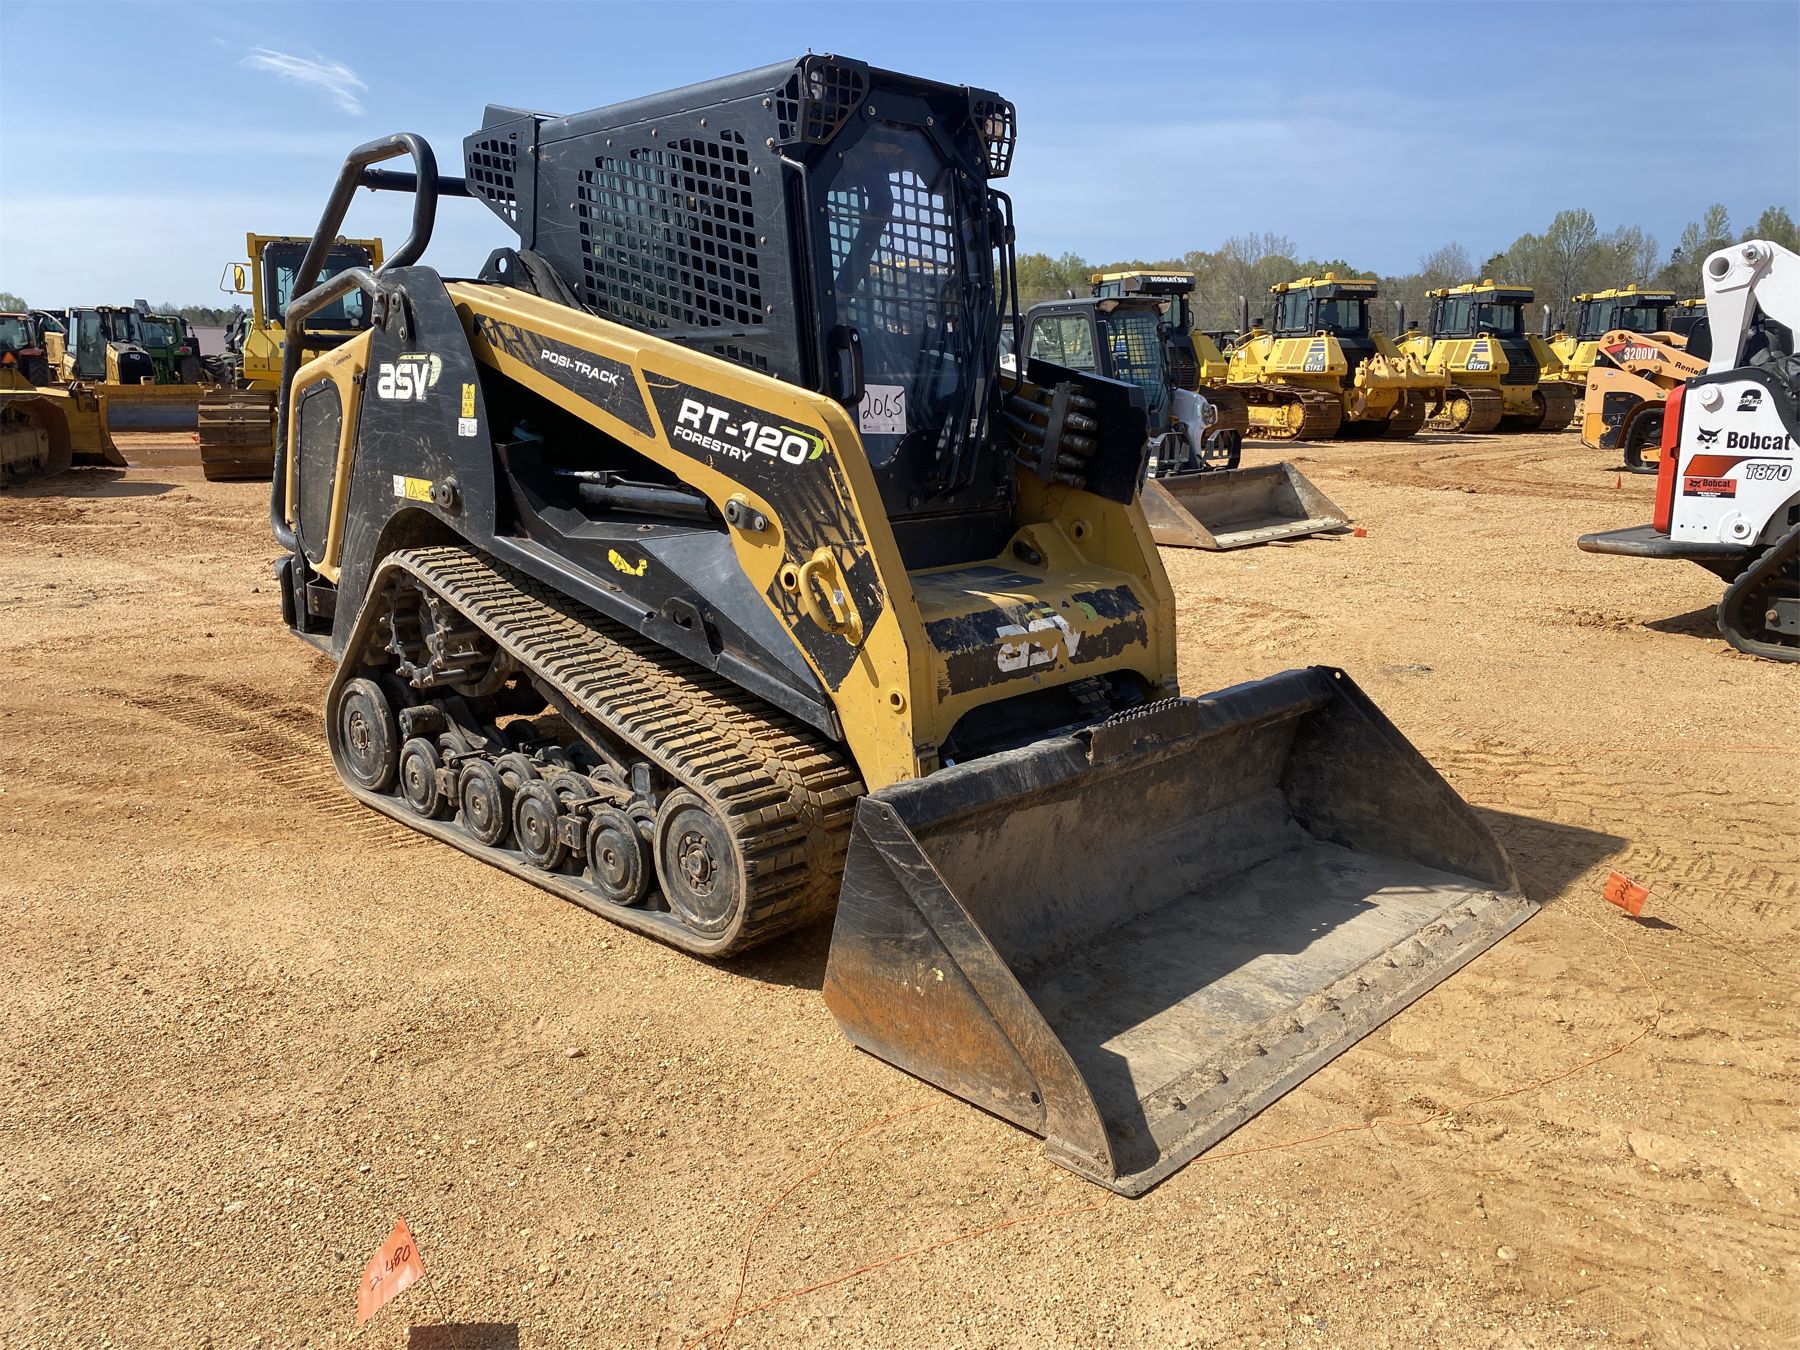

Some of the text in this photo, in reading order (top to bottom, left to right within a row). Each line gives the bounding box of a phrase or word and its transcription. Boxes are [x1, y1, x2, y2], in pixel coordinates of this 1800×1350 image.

[1623, 347, 1659, 361] 3200VT
[541, 349, 619, 387] POSI-TRACK
[1674, 361, 1700, 376] Renta
[862, 390, 905, 419] 2065
[1736, 389, 1762, 412] 2
[677, 398, 809, 465] RT-120
[1726, 431, 1791, 451] Bobcat
[673, 425, 752, 462] FORESTRY
[1745, 463, 1793, 482] T870
